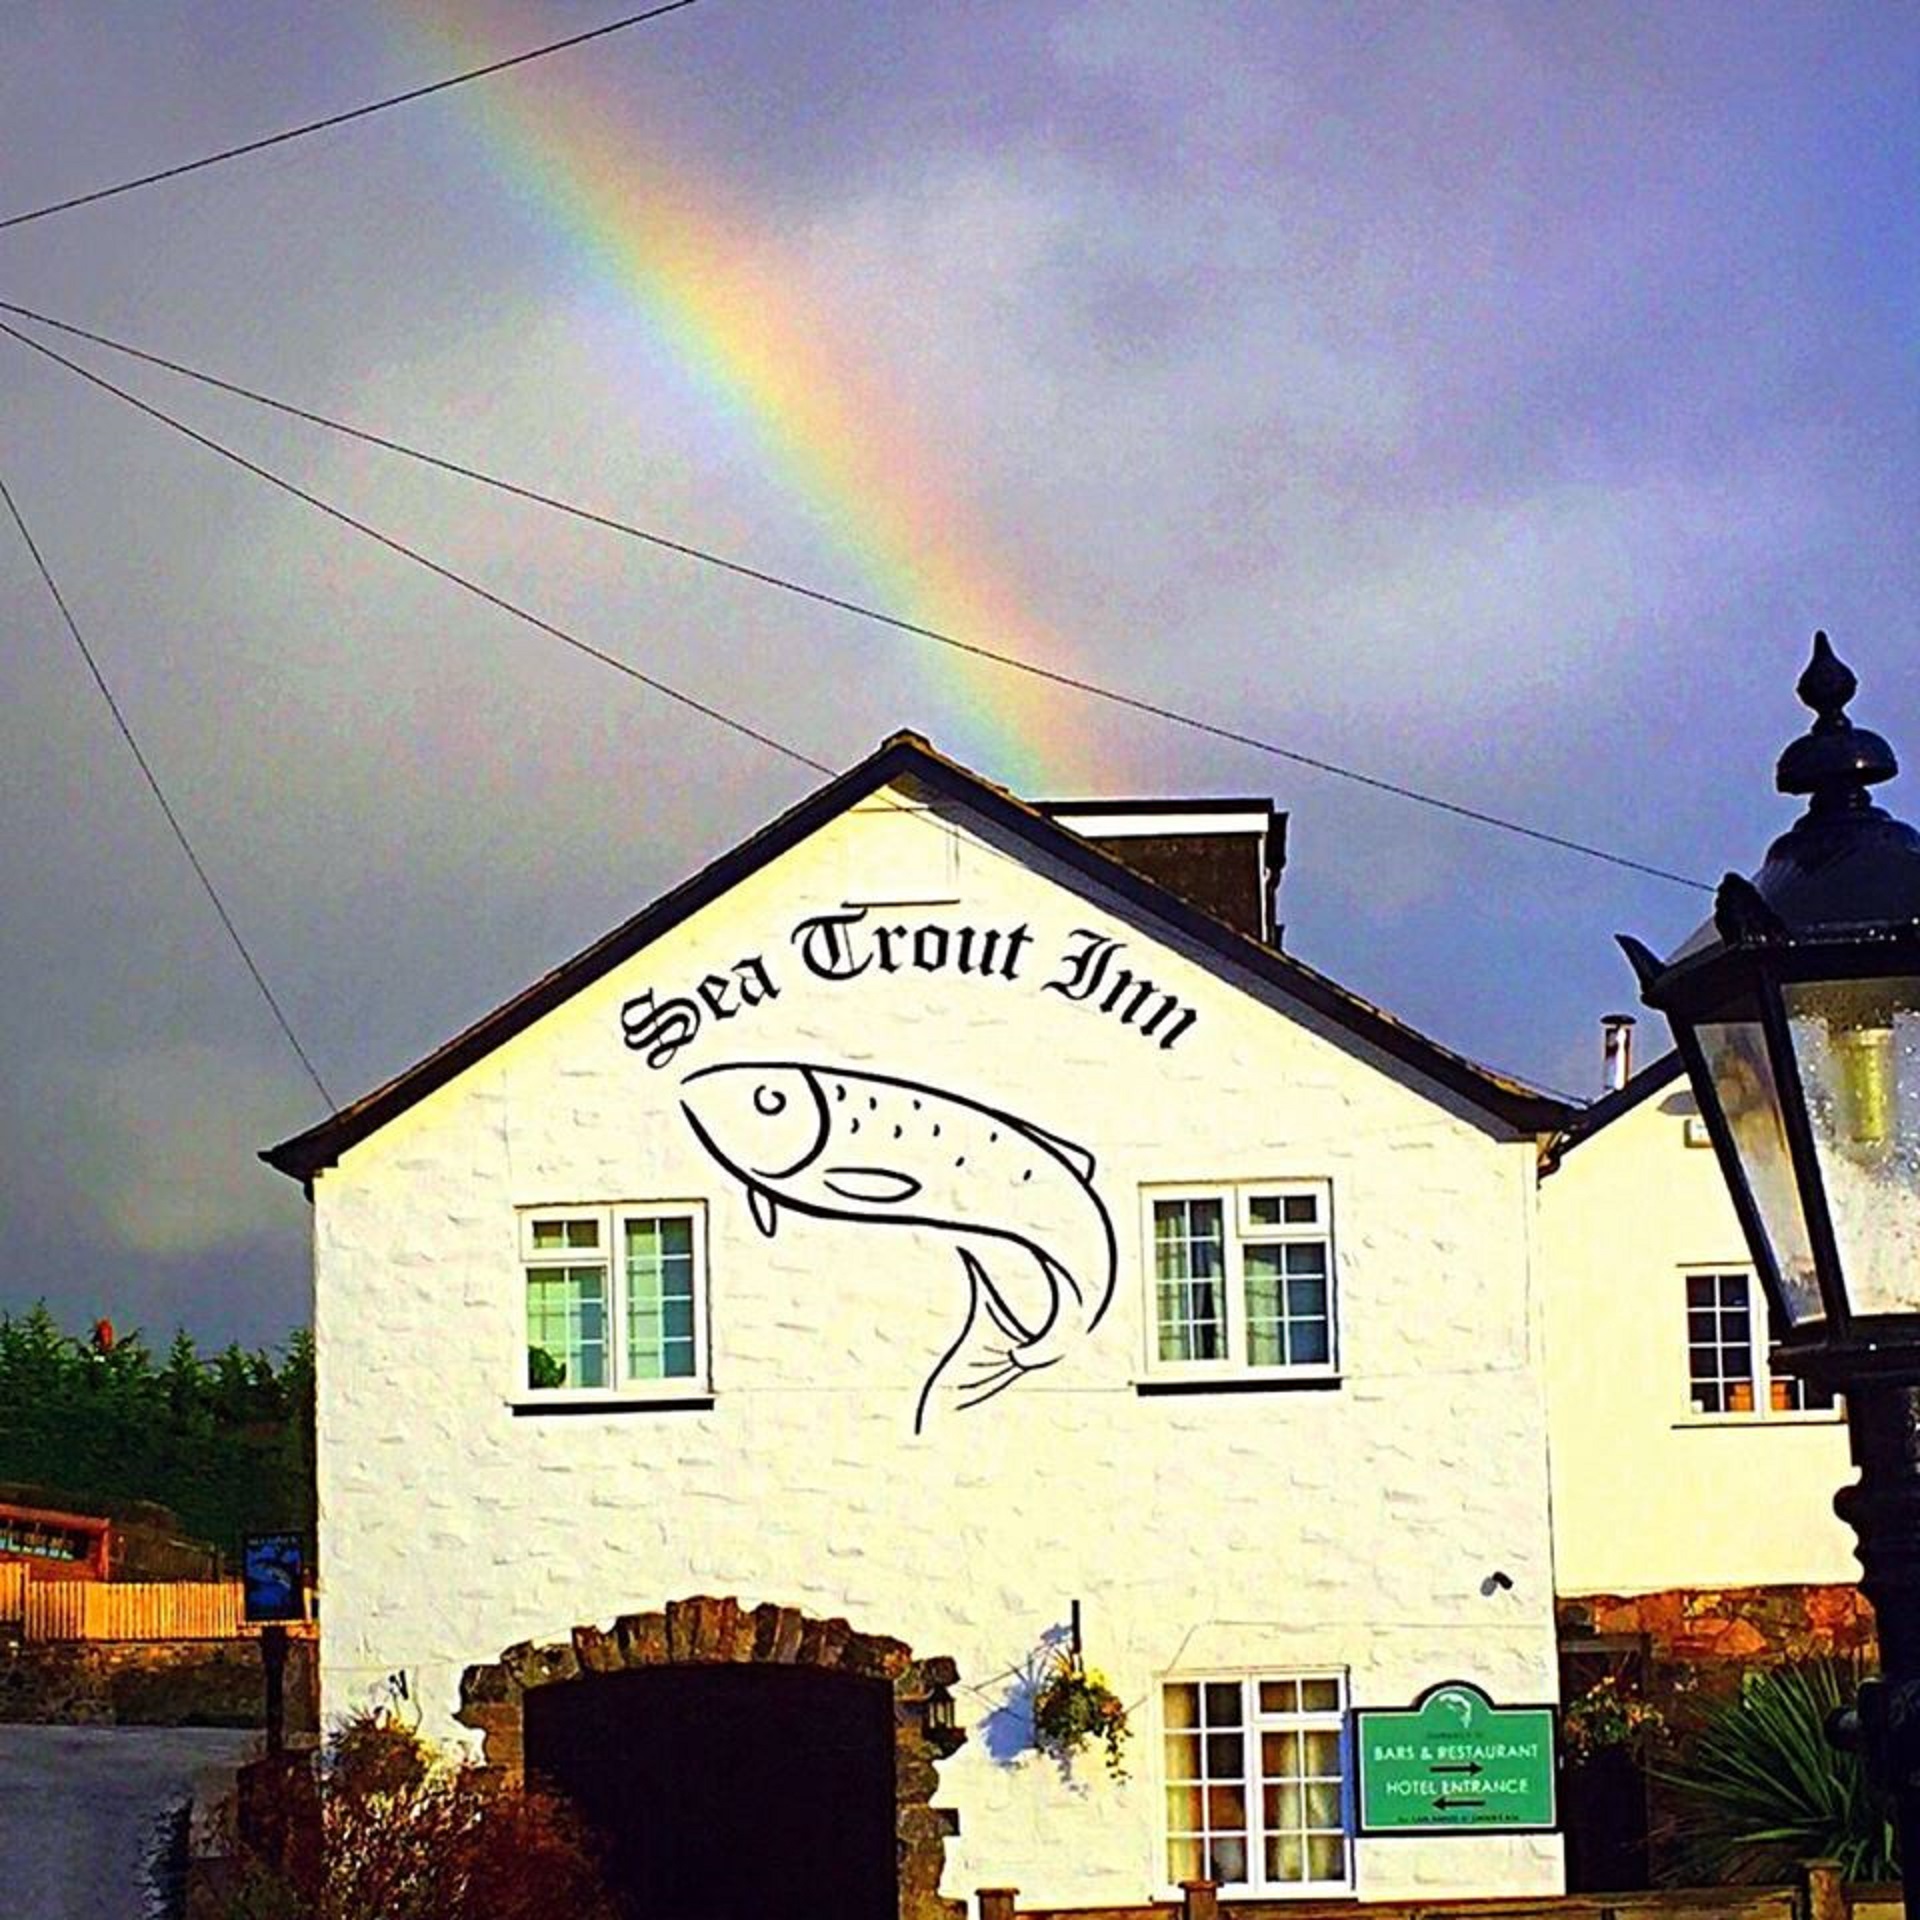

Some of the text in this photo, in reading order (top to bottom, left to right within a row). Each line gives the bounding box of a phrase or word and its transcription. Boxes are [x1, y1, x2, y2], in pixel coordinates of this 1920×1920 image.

[621, 906, 1198, 1069] Sea Trout Inn
[1374, 1743, 1539, 1761] BARS & RESTAURANT
[1385, 1777, 1530, 1796] HOTEL ENTRANCE
